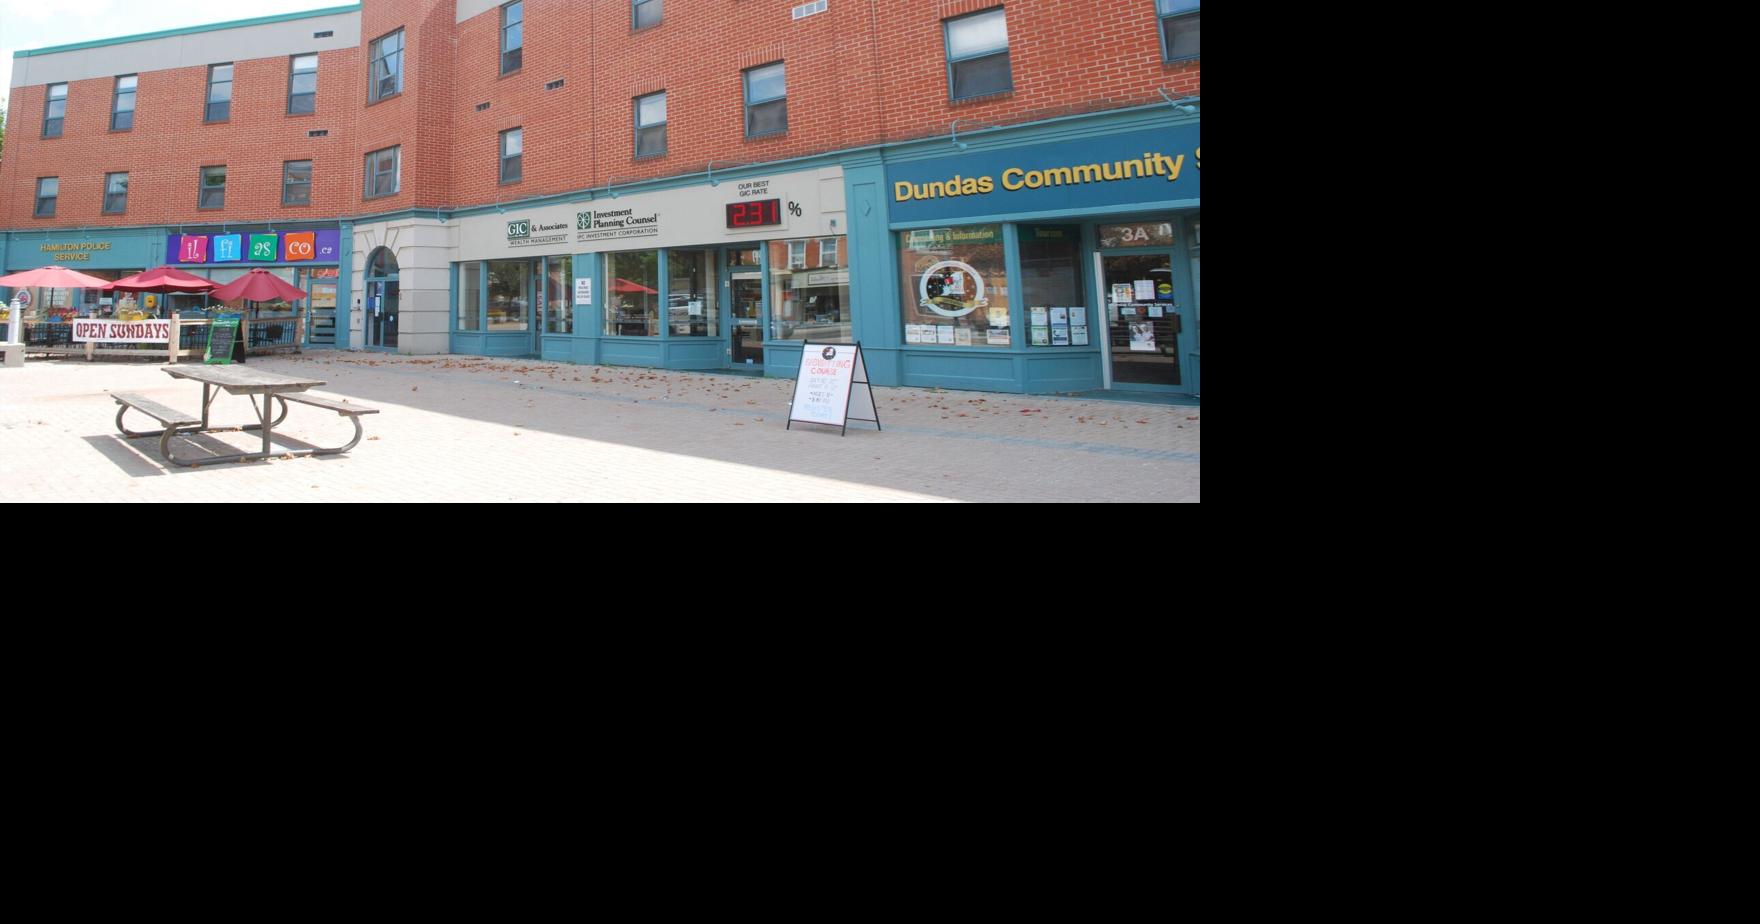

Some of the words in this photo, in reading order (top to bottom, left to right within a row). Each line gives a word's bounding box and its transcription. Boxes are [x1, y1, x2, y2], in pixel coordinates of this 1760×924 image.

[895, 174, 994, 202] Dundas
[1001, 152, 1185, 191] Community
[738, 182, 752, 190] OUR
[753, 180, 769, 188] BEST
[739, 189, 751, 197] GIC
[593, 208, 632, 219] Investment
[733, 200, 776, 225] 2.31
[788, 201, 802, 217] %
[593, 219, 625, 231] Planning
[626, 213, 658, 226] Counsel
[508, 222, 528, 236] GIC
[531, 224, 537, 232] &
[538, 222, 569, 232] Associates
[586, 231, 617, 239] INVESTMENT
[618, 228, 659, 237] CORPORATION
[1121, 226, 1150, 242] 3A
[510, 238, 530, 246] WEALTH
[530, 235, 567, 244] MANAGEMENT
[40, 243, 80, 252] HAMILTON
[81, 241, 112, 251] POLICE
[54, 252, 90, 261] SERVICE
[76, 322, 108, 338] OPEN
[109, 323, 169, 339] SUNDAYS
